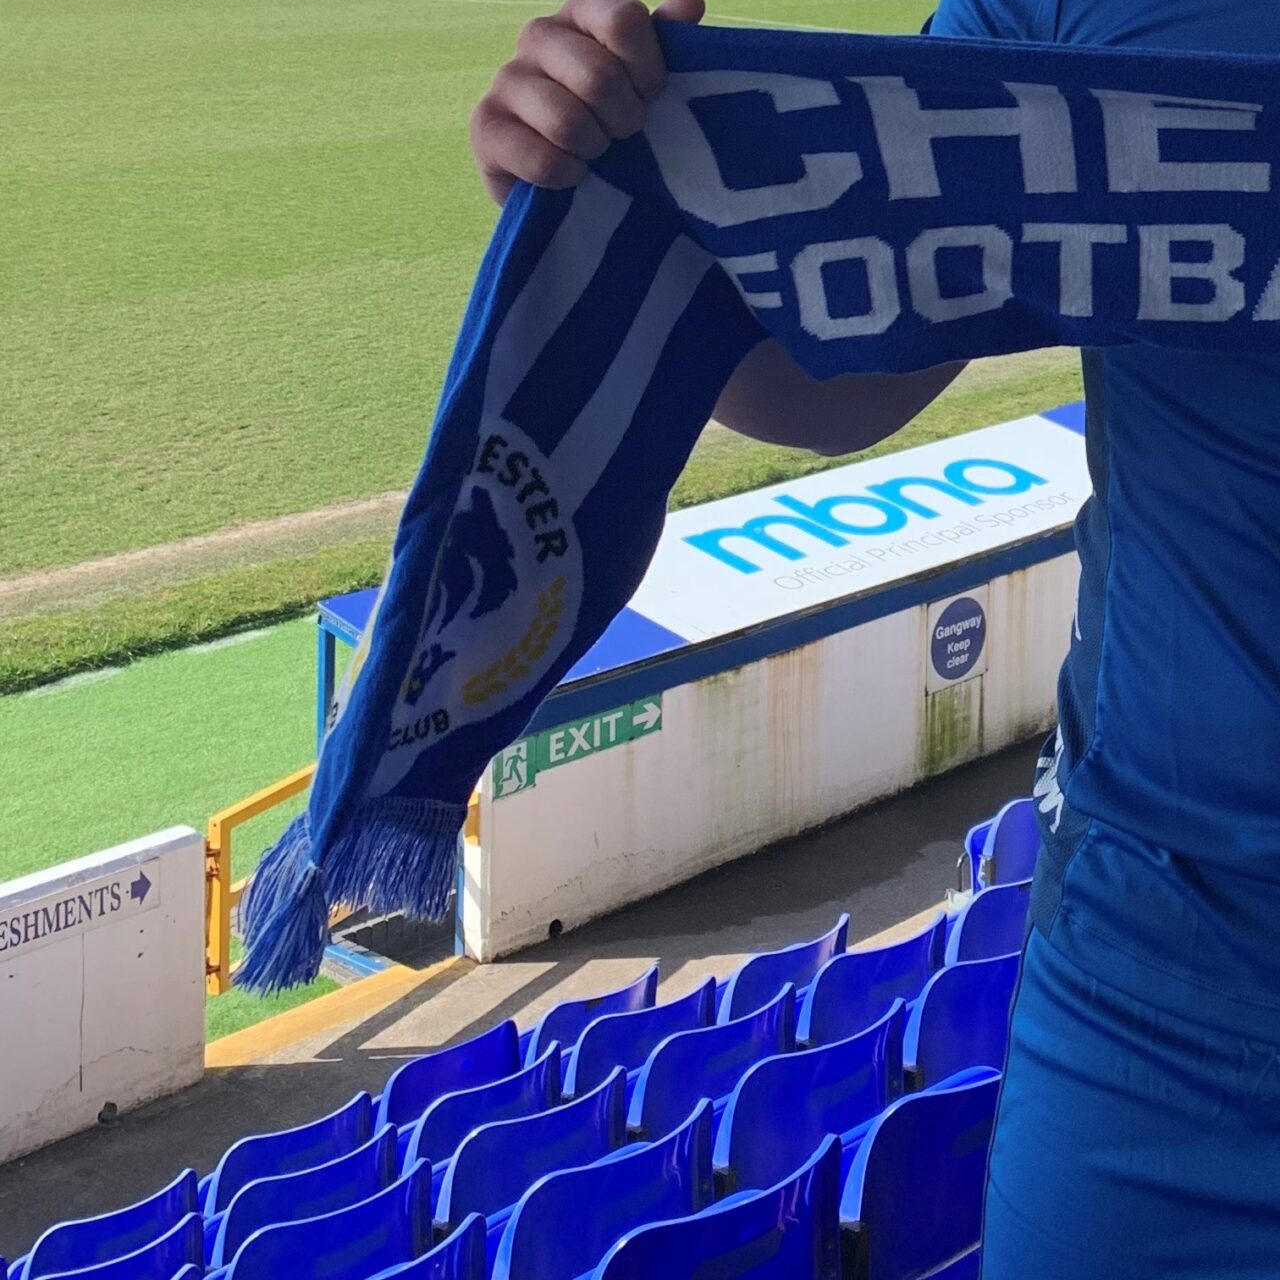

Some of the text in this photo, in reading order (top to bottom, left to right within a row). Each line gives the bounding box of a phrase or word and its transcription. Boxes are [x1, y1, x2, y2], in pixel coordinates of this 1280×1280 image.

[681, 458, 1051, 575] mbna
[773, 491, 1075, 591] Official Principal Sponsor
[935, 615, 983, 640] Gangway
[947, 638, 971, 655] Keep
[946, 652, 970, 669] clear
[550, 711, 624, 763] EXIT
